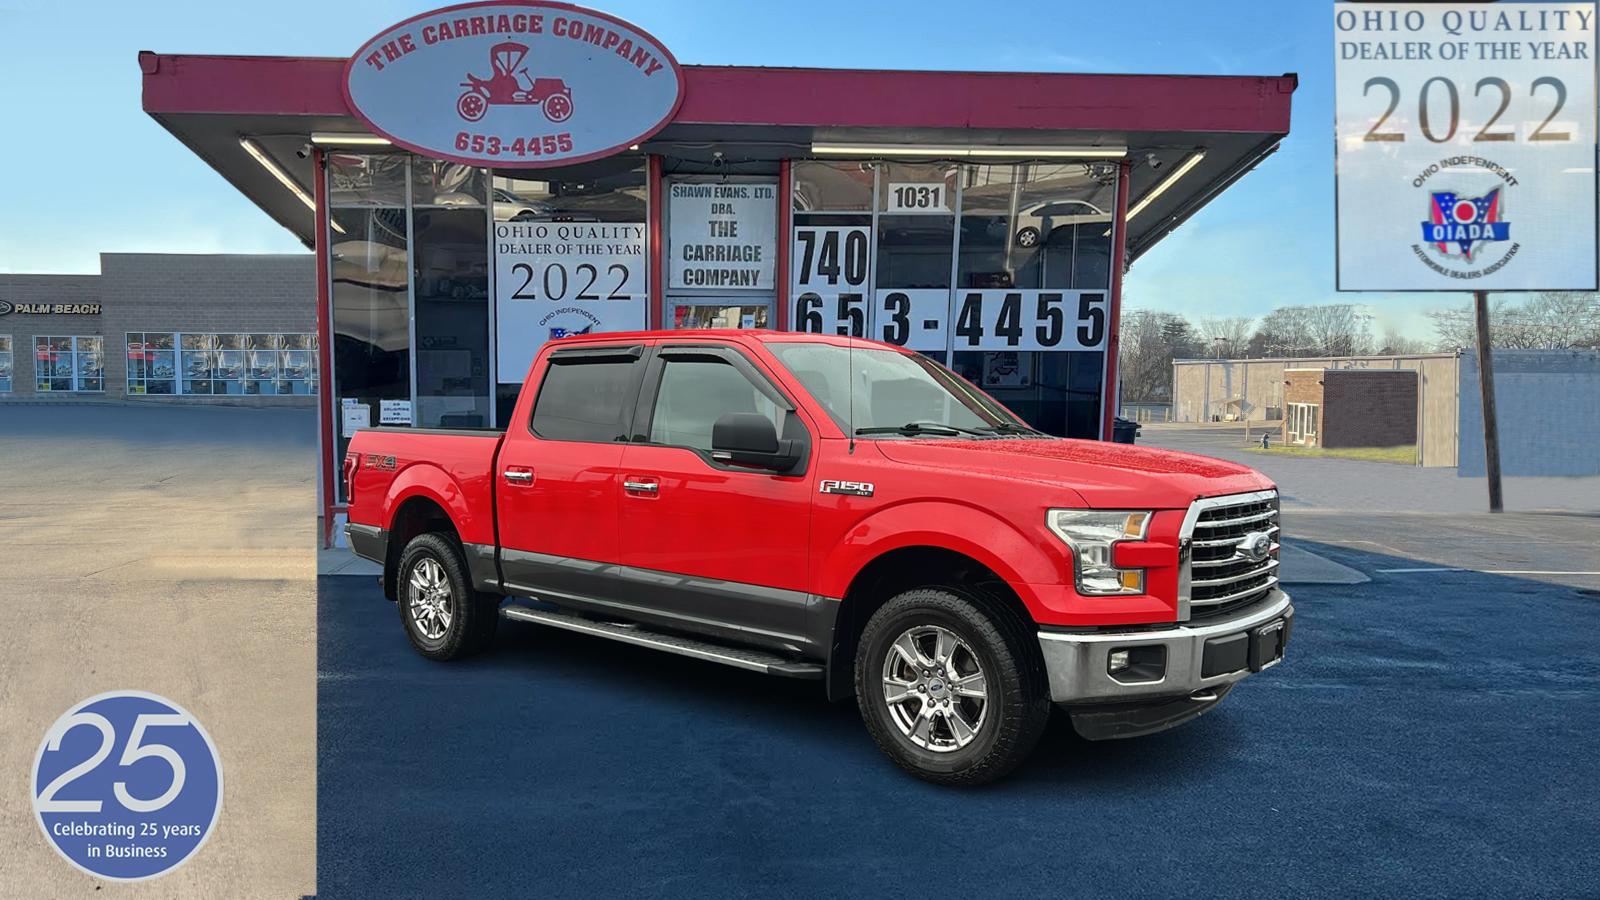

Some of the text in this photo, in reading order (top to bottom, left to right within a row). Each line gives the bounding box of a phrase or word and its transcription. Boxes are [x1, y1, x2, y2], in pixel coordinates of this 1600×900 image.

[1336, 10, 1593, 35] OHIO QUALITY
[366, 14, 663, 77] THE CARRIAGE COMPANY
[1340, 42, 1589, 60] DEALER OF THE YEAR
[1362, 76, 1571, 143] 2022
[455, 132, 573, 157] 653-4455
[1412, 155, 1519, 188] OHIO INDEPENDENT
[672, 186, 712, 199] SHAWN
[754, 188, 775, 199] LTD.
[894, 187, 940, 208] 1031
[711, 203, 736, 215] DBA.
[496, 226, 643, 241] OHIO QUALITY
[708, 220, 738, 238] THE
[1432, 224, 1495, 240] OIADA
[499, 243, 641, 255] DEALER OF THE YEAR
[683, 244, 762, 263] CARRIAGE
[797, 230, 868, 286] 740
[511, 263, 631, 300] 2022
[683, 268, 761, 286] COMPANY
[14, 303, 100, 315] PALM BEACH
[539, 307, 601, 327] OHIO INDEPENDENT
[365, 454, 397, 472] FX4
